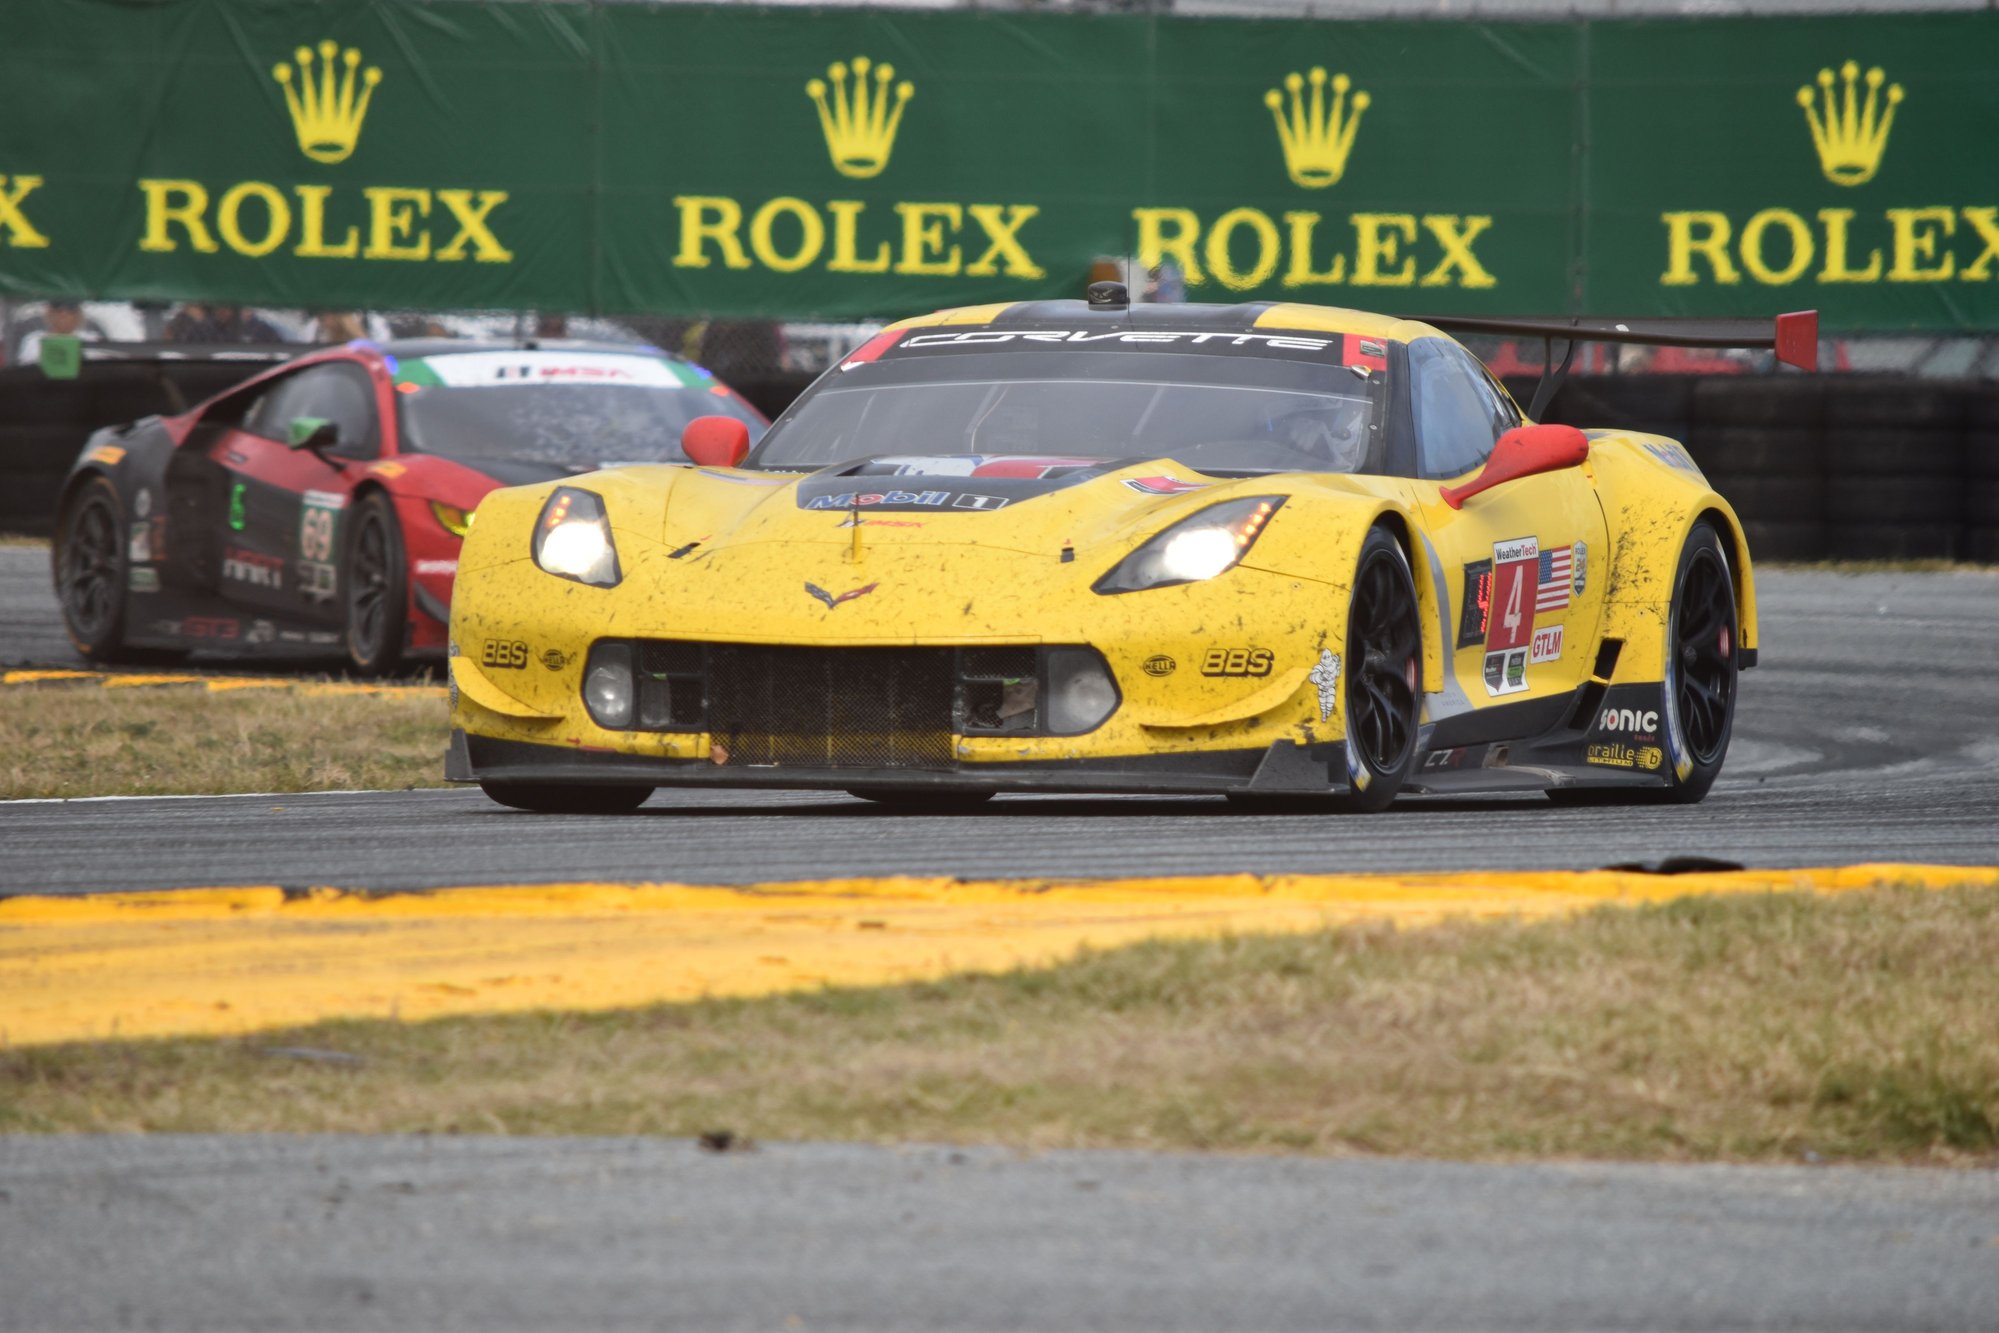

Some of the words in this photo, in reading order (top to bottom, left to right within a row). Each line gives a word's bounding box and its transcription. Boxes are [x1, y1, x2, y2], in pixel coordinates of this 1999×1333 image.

[139, 179, 513, 262] ROLEX
[673, 195, 1045, 279] ROLEX
[1131, 207, 1497, 290] ROLEX
[899, 331, 1334, 351] CORVETTE
[804, 490, 950, 508] Mobil
[1496, 543, 1536, 559] WeatherTech
[1503, 565, 1523, 643] 4
[482, 639, 528, 670] BBS
[1533, 631, 1561, 657] GTLM
[1145, 659, 1177, 672] HELLA
[1201, 648, 1275, 678] BBS
